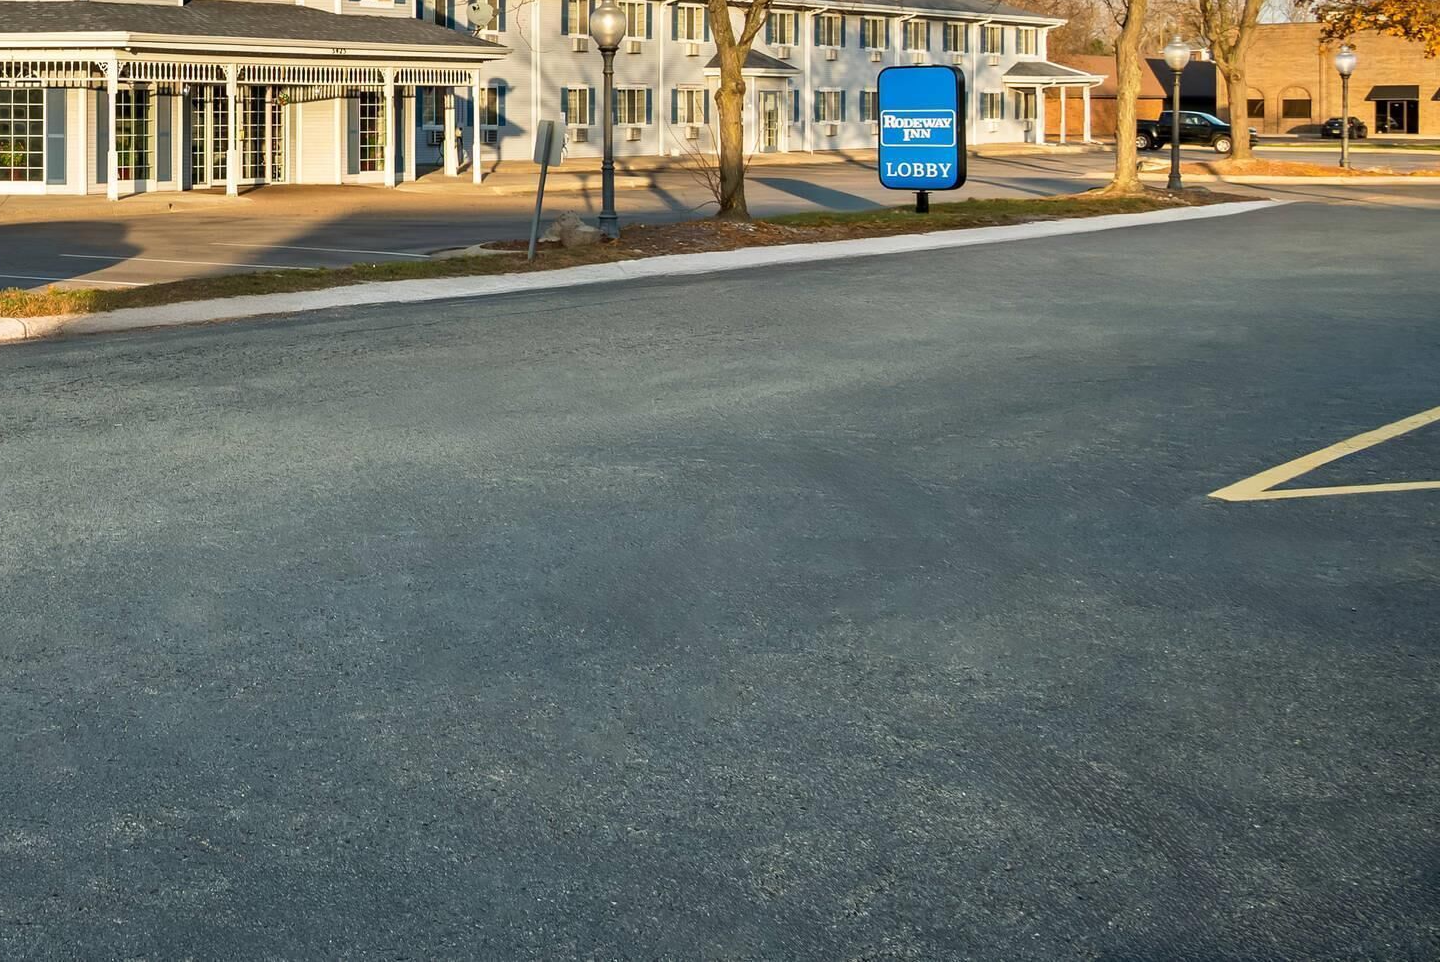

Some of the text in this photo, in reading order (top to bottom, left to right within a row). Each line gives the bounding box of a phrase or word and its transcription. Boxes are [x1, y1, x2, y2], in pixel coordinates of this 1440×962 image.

[883, 115, 952, 128] RODEWAY
[903, 128, 931, 141] INN
[885, 162, 952, 178] LOBBY
